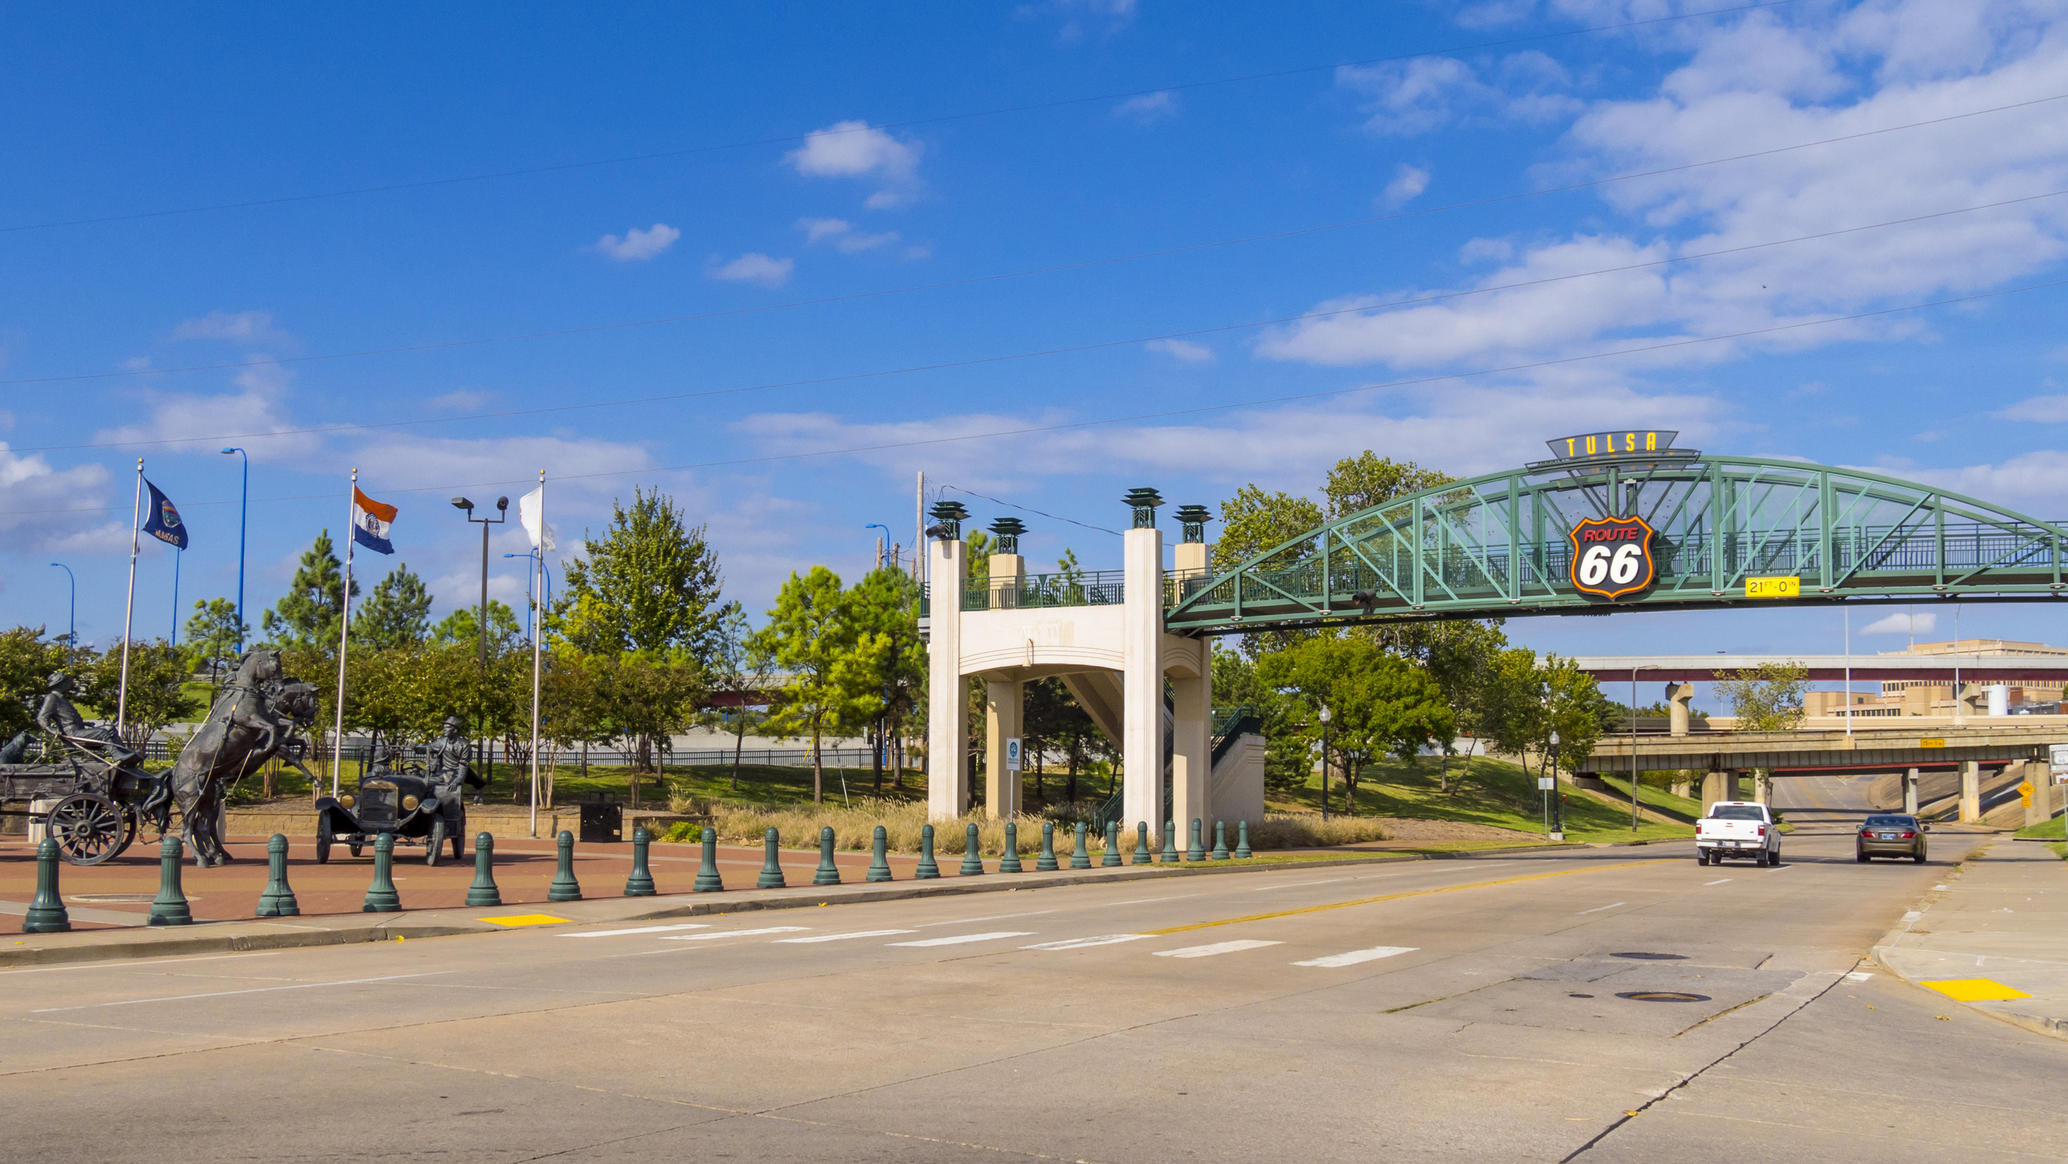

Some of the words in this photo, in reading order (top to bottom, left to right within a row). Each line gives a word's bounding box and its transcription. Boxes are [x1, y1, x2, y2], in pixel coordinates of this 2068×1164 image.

[1566, 432, 1656, 457] TULSA
[1583, 527, 1638, 542] ROUTE
[1580, 543, 1642, 586] 66
